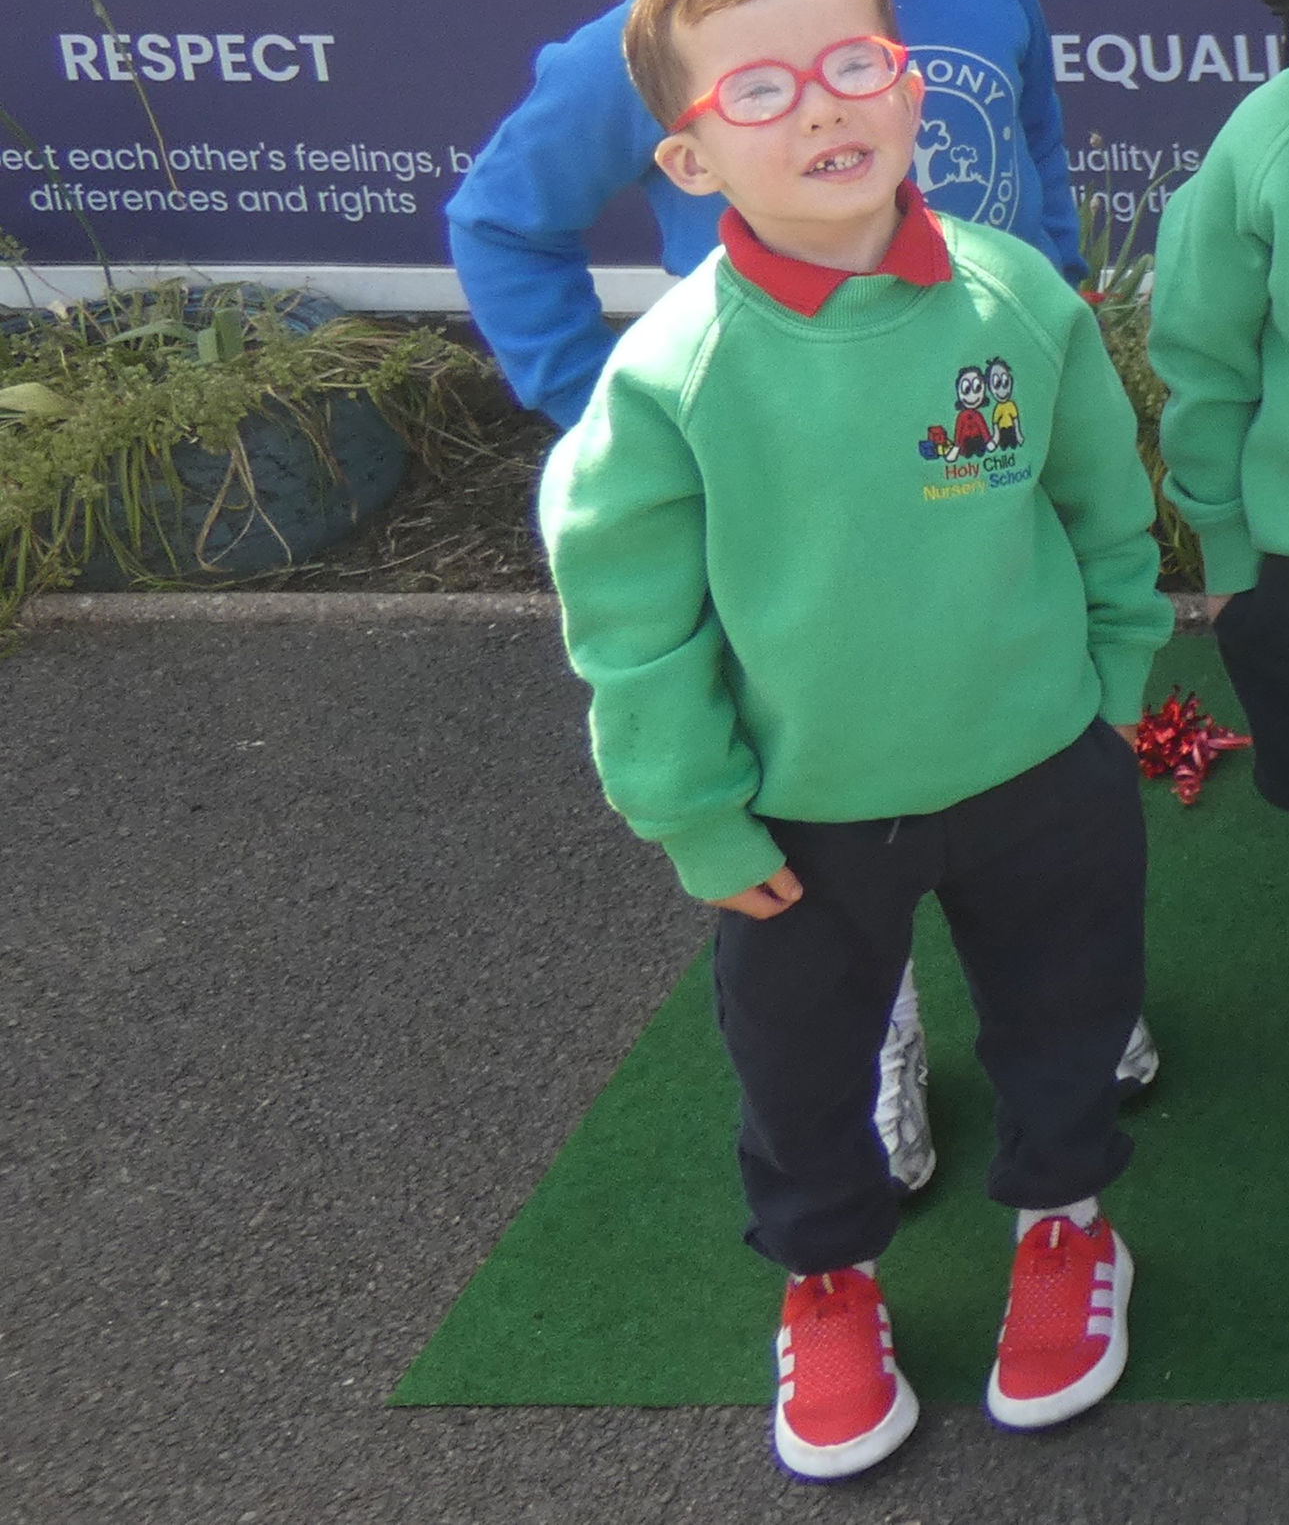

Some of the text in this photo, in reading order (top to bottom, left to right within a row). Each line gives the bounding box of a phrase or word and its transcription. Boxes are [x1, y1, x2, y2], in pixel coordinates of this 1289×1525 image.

[59, 34, 335, 82] RESPECT
[69, 143, 158, 171] each
[169, 143, 287, 172] other's
[298, 143, 442, 181] feelings,
[1066, 143, 1200, 180] uality is
[30, 184, 417, 222] differences and rights
[922, 464, 1033, 502] Nursery School
[945, 452, 1017, 480] Holy Child
